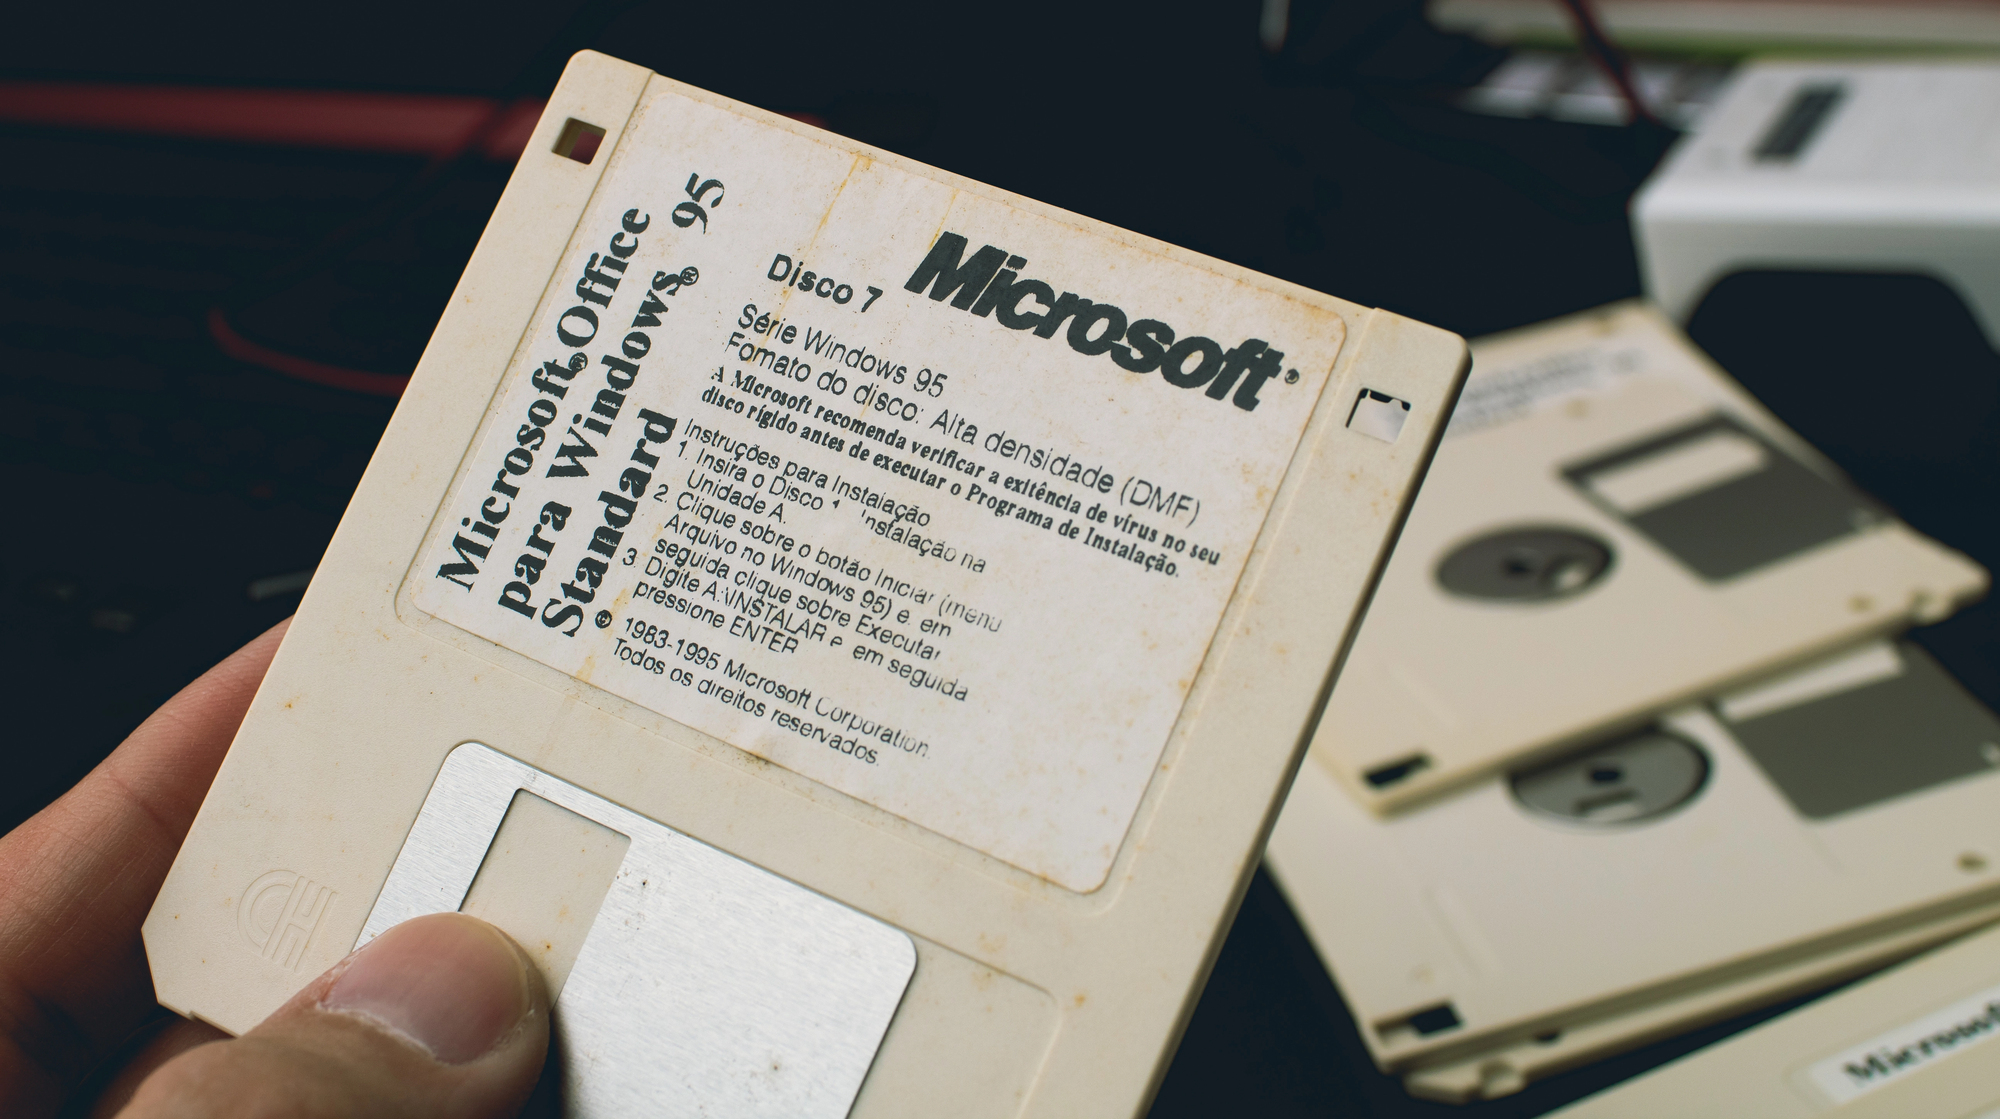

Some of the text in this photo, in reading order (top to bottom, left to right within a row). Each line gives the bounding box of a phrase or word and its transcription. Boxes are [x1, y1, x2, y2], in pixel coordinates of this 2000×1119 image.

[557, 208, 650, 347] Office
[767, 253, 883, 313] Disco 7
[498, 501, 572, 620] para
[672, 172, 725, 234] 95
[738, 303, 948, 397] Série Windows 95
[684, 418, 780, 469] Instruções
[783, 461, 828, 488] para
[702, 386, 1179, 578] disco rígido antes de executar o Programa de Instalação.
[711, 365, 1220, 566] A Microsoft recomenda verificar a exitência de vírus no seu
[725, 332, 1200, 528] Fomato do disco: Alta densidade (DMF)
[541, 408, 678, 637] Standard
[653, 483, 668, 503] 2.
[677, 492, 736, 528] Clique
[740, 520, 795, 552] sobre
[798, 544, 811, 558] o
[815, 546, 871, 582] botão
[938, 594, 1003, 634] (menu
[678, 440, 688, 460] 1.
[696, 448, 747, 482] Insira
[752, 473, 765, 488] o
[768, 475, 823, 510] Disco
[961, 553, 986, 574] na
[687, 469, 786, 524] Unidade A.
[632, 581, 798, 655] pressione ENTER
[644, 556, 700, 592] Digite
[852, 645, 884, 666] em
[887, 658, 968, 701] seguida
[654, 538, 730, 580] seguida
[734, 571, 791, 603] clique
[796, 594, 851, 627] sobre
[664, 514, 737, 555] Arquivo
[741, 546, 765, 566] no
[771, 553, 855, 602] Windows
[859, 590, 892, 620] 95)
[920, 619, 952, 639] em
[613, 638, 879, 766] Todos os direitos reservados.
[625, 617, 721, 671] 1983-1995
[723, 659, 812, 710] Microsoft
